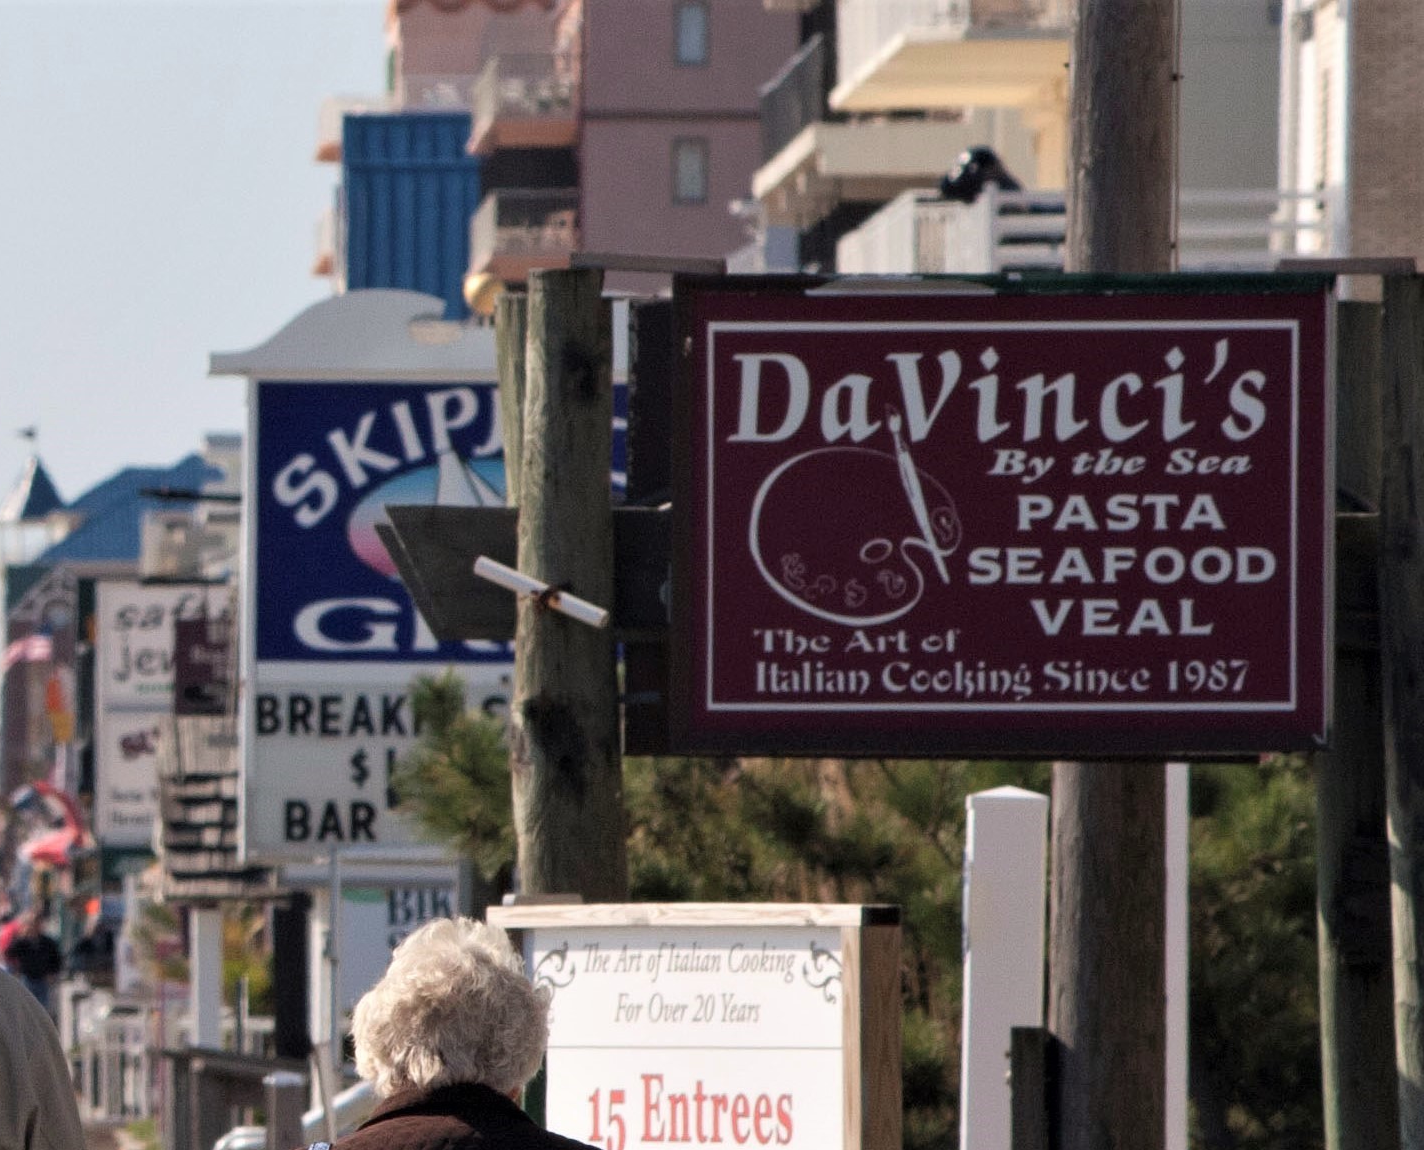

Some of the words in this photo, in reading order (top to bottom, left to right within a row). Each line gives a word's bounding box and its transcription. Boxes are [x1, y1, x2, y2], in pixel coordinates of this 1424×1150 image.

[726, 338, 1268, 442] DaVinci's
[273, 386, 504, 529] SKIPJ
[988, 449, 1055, 484] By
[1071, 449, 1146, 475] the
[1165, 448, 1253, 475] Sea
[1016, 494, 1227, 531] PASTA
[967, 547, 1278, 585] SEAFOOD
[1030, 598, 1214, 636] VEAL
[753, 628, 831, 655] The
[844, 628, 910, 653] Art
[921, 628, 962, 653] of
[755, 661, 871, 694] Italian
[882, 661, 1032, 700] Cooking
[1043, 660, 1151, 694] Since
[1165, 659, 1249, 693] 1987
[256, 693, 507, 737] BREAK
[283, 799, 377, 842] BAR
[583, 941, 611, 973] The
[613, 942, 644, 973] Art
[646, 941, 669, 983] of
[666, 941, 722, 973] Italian
[727, 941, 797, 984] Cooking
[614, 992, 643, 1023] For
[648, 992, 689, 1023] Over
[692, 993, 716, 1023] 20
[720, 992, 761, 1023] Years
[640, 1073, 794, 1146] Entrees
